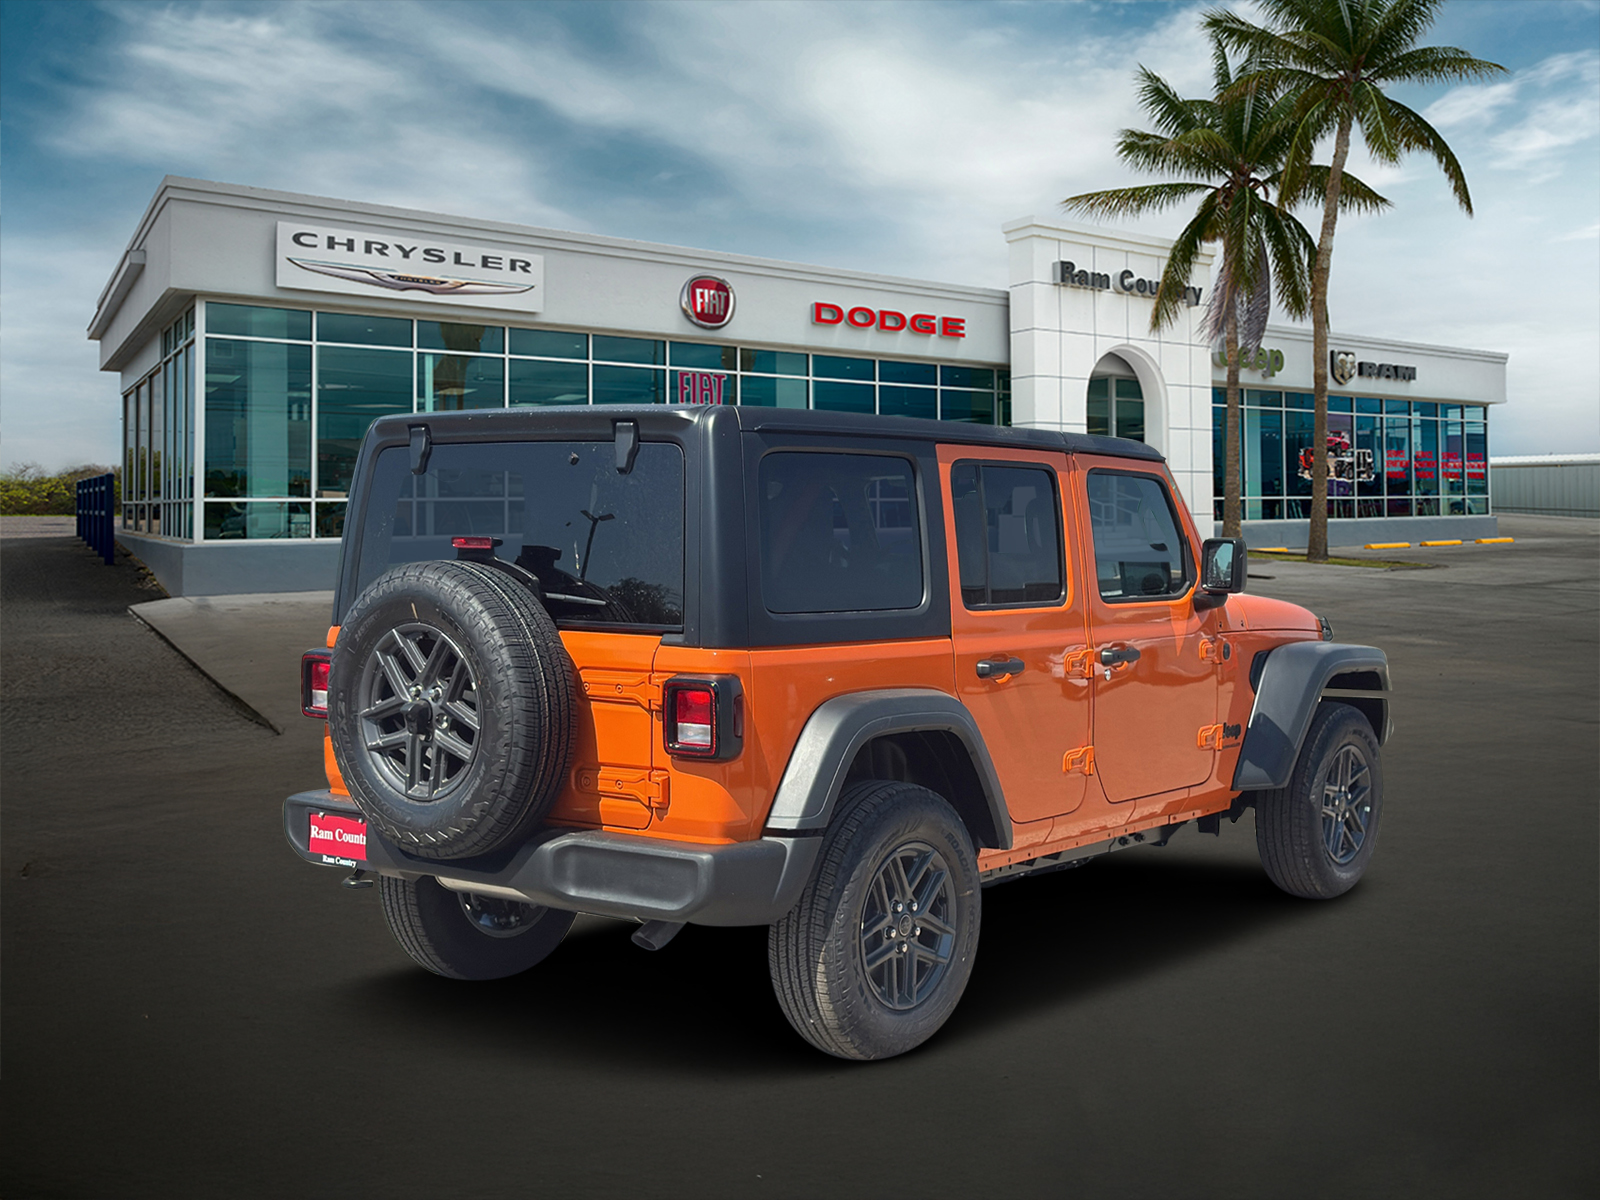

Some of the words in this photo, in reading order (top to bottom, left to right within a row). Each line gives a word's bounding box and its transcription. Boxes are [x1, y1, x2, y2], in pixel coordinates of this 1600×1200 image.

[292, 231, 532, 274] CHRYSLER
[1054, 260, 1111, 291] Ram
[1115, 269, 1203, 307] Coury
[695, 288, 728, 316] FIAT
[812, 301, 967, 338] DODGE
[678, 371, 727, 405] FIAT
[1358, 361, 1417, 381] RAM
[311, 825, 333, 841] Ram
